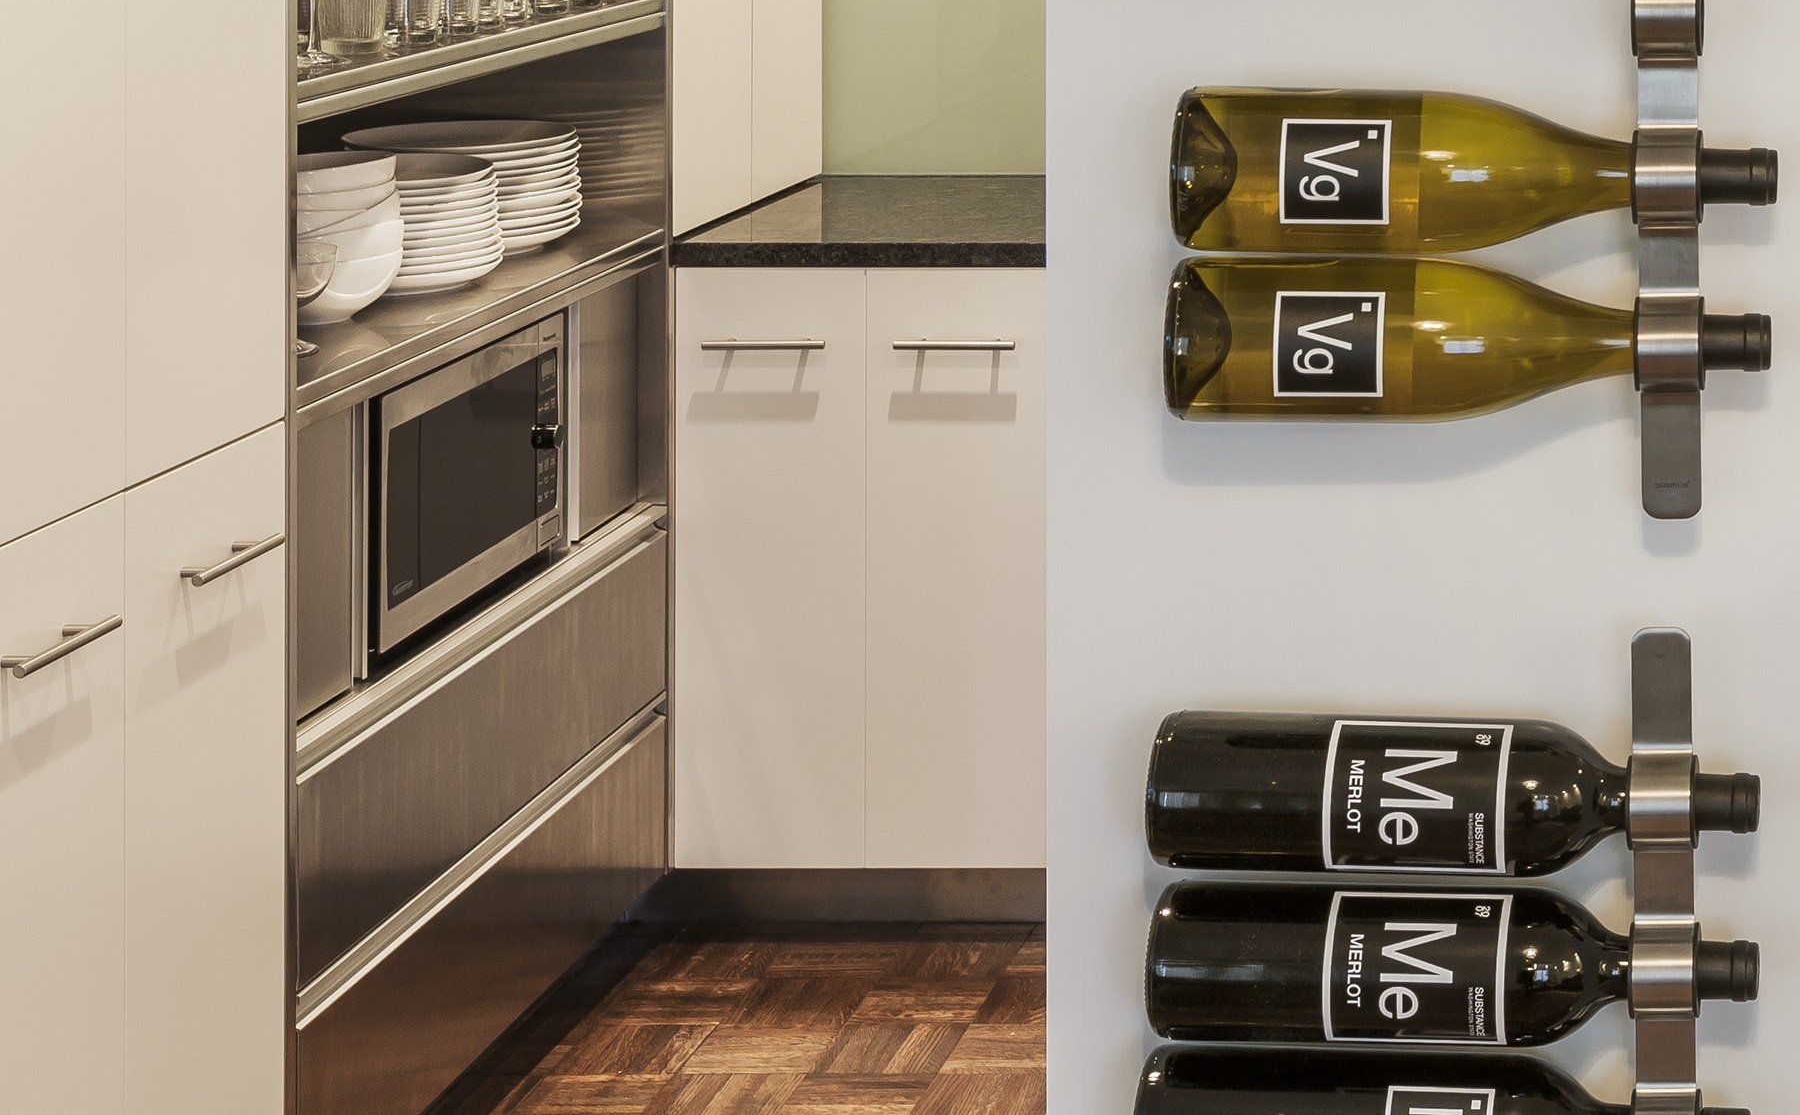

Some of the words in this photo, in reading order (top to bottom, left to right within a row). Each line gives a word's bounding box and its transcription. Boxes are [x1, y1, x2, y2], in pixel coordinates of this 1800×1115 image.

[1299, 140, 1360, 201] Vg
[1292, 312, 1354, 375] Vg
[1347, 759, 1365, 833] MERLOT
[1378, 748, 1458, 845] Me
[1474, 812, 1484, 864] SUBSTANCE
[1347, 933, 1365, 1007] MERLOT
[1378, 922, 1457, 1020] Me
[1474, 986, 1485, 1037] SUBSTANCE
